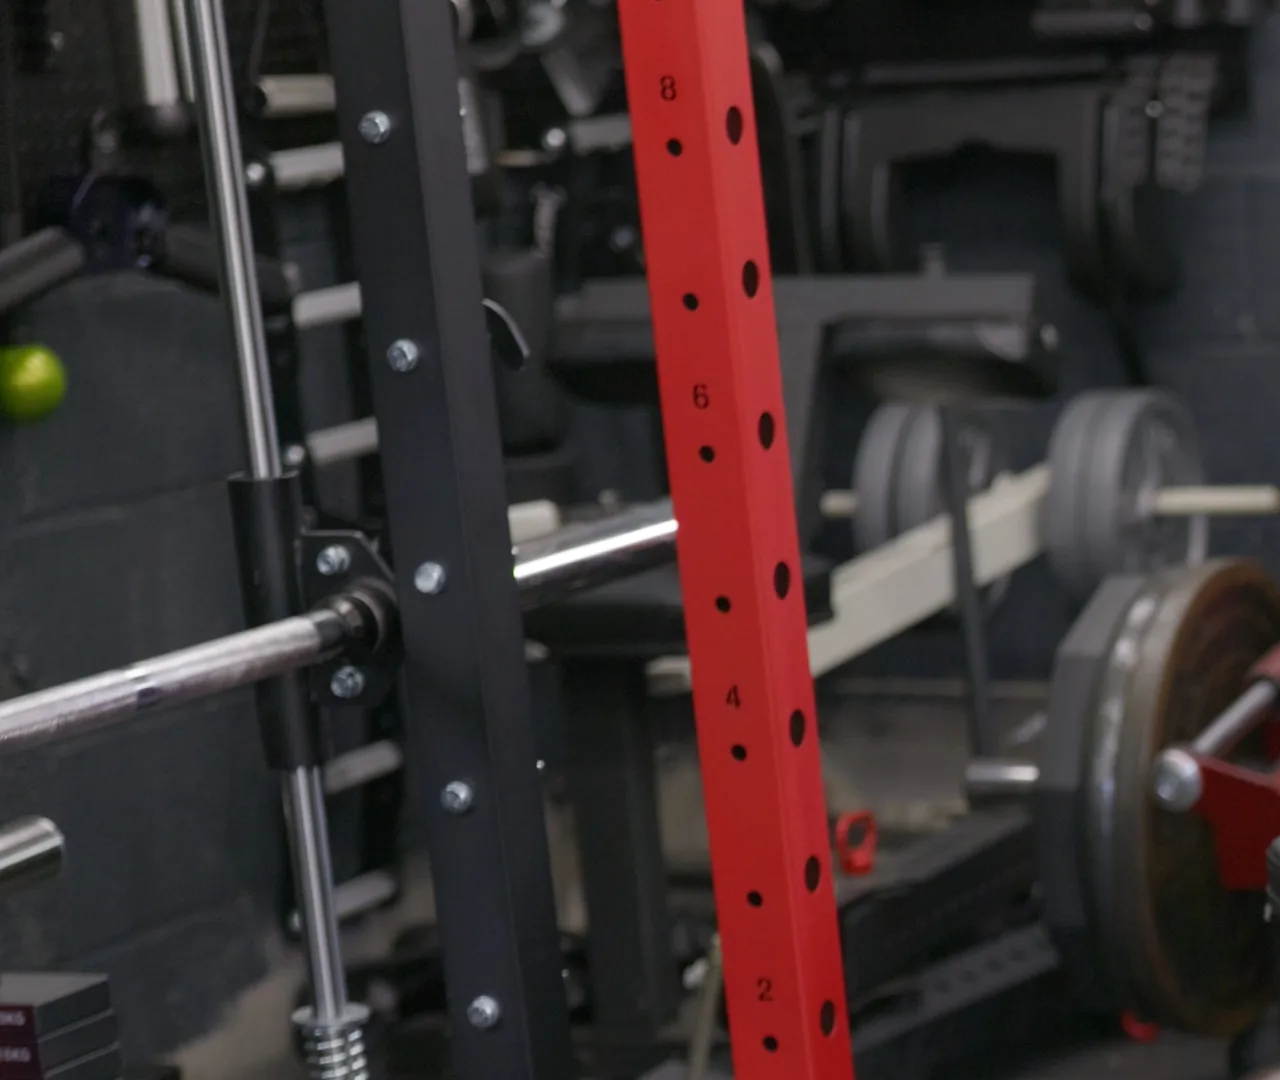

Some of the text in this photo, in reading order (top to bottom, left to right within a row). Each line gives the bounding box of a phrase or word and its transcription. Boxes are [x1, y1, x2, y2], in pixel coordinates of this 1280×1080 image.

[660, 75, 677, 102] 8
[692, 383, 710, 410] 6
[725, 684, 741, 710] 4
[756, 976, 774, 1003] 2
